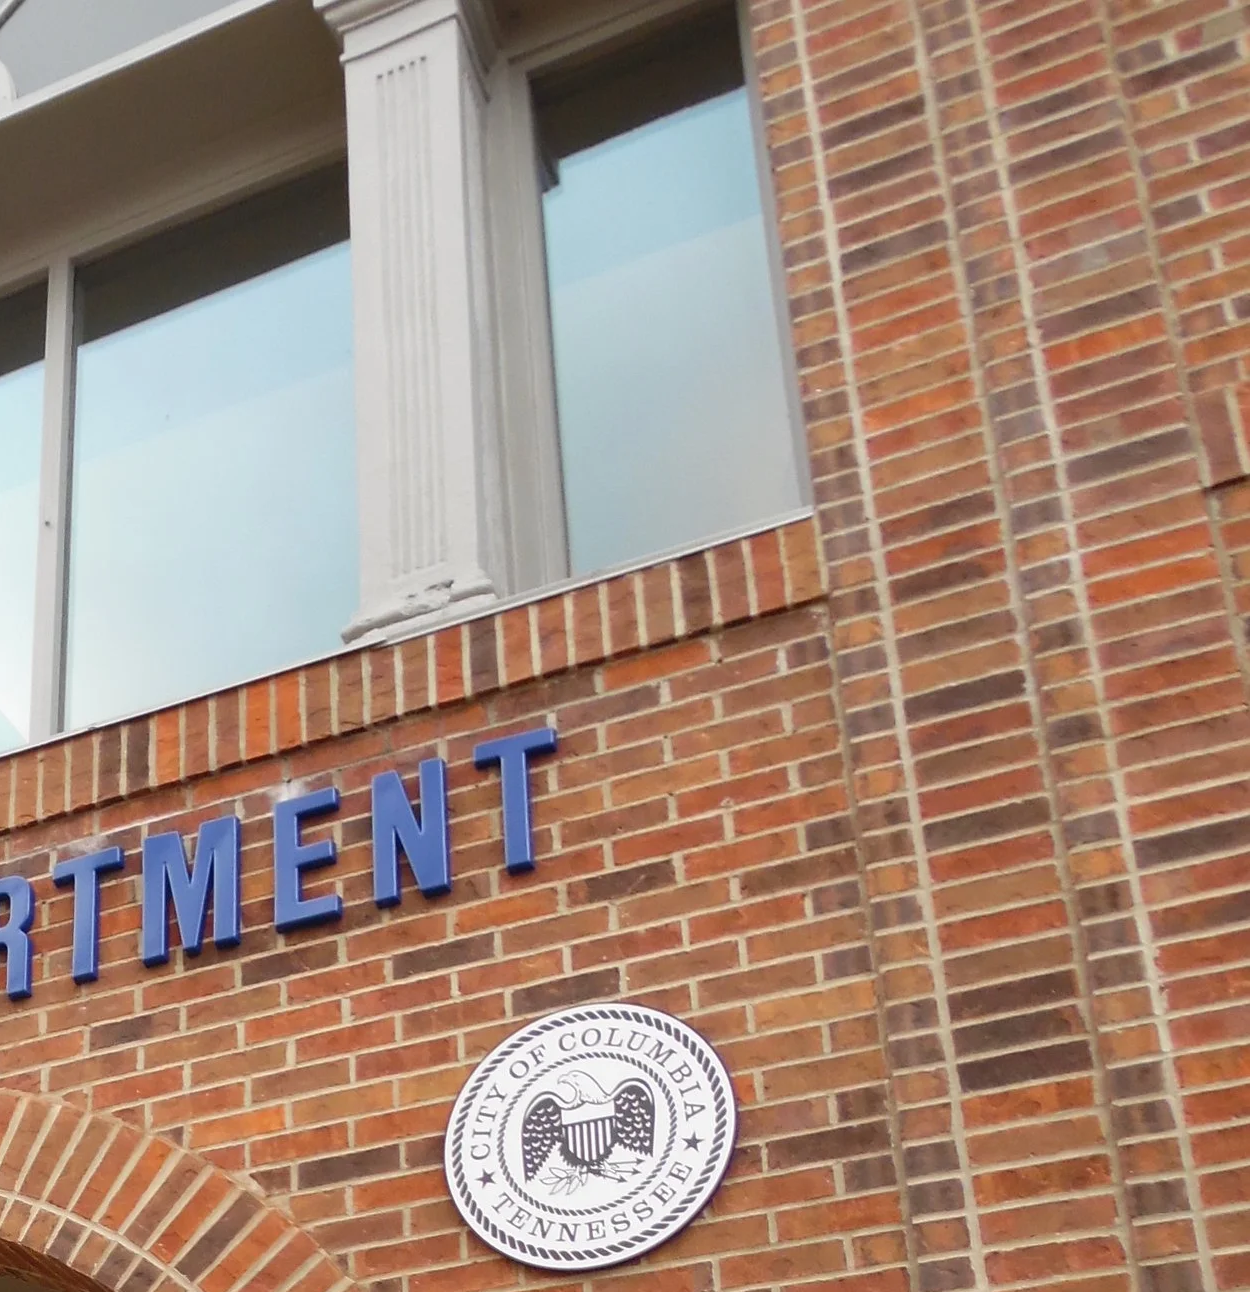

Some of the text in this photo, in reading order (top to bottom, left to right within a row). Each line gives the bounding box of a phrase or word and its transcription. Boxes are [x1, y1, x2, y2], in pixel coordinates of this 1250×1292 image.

[471, 1027, 707, 1161] CITY OF COLUMBIA
[490, 1161, 693, 1243] TENNESSEE
